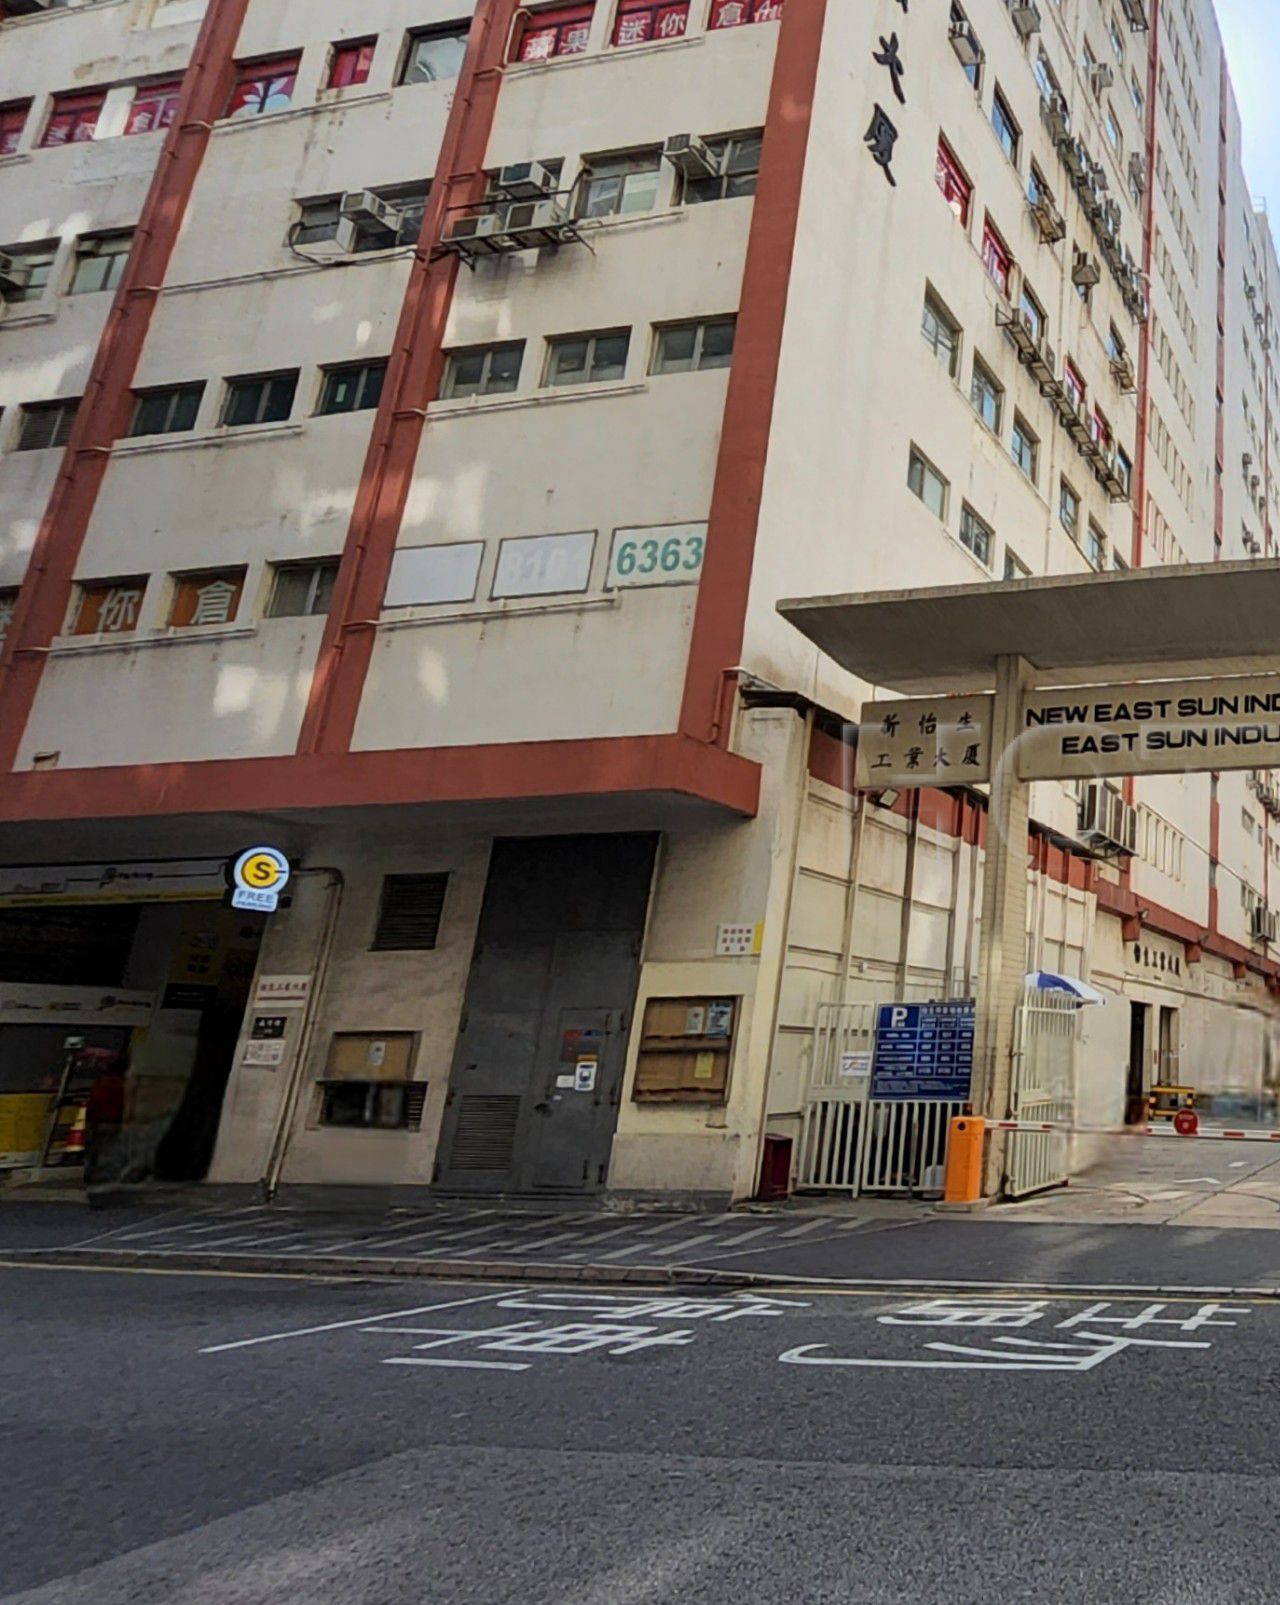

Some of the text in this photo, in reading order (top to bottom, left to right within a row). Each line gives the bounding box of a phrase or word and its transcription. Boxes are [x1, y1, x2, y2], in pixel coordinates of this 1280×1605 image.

[616, 536, 703, 575] 6363
[1026, 705, 1089, 726] NEW
[1094, 699, 1172, 722] EAST
[1177, 695, 1239, 717] SUN
[880, 711, 974, 738] 新怡生
[1061, 732, 1139, 755] EAST
[1146, 727, 1208, 750] SUN
[238, 890, 274, 903] FREE
[891, 1007, 908, 1028] P
